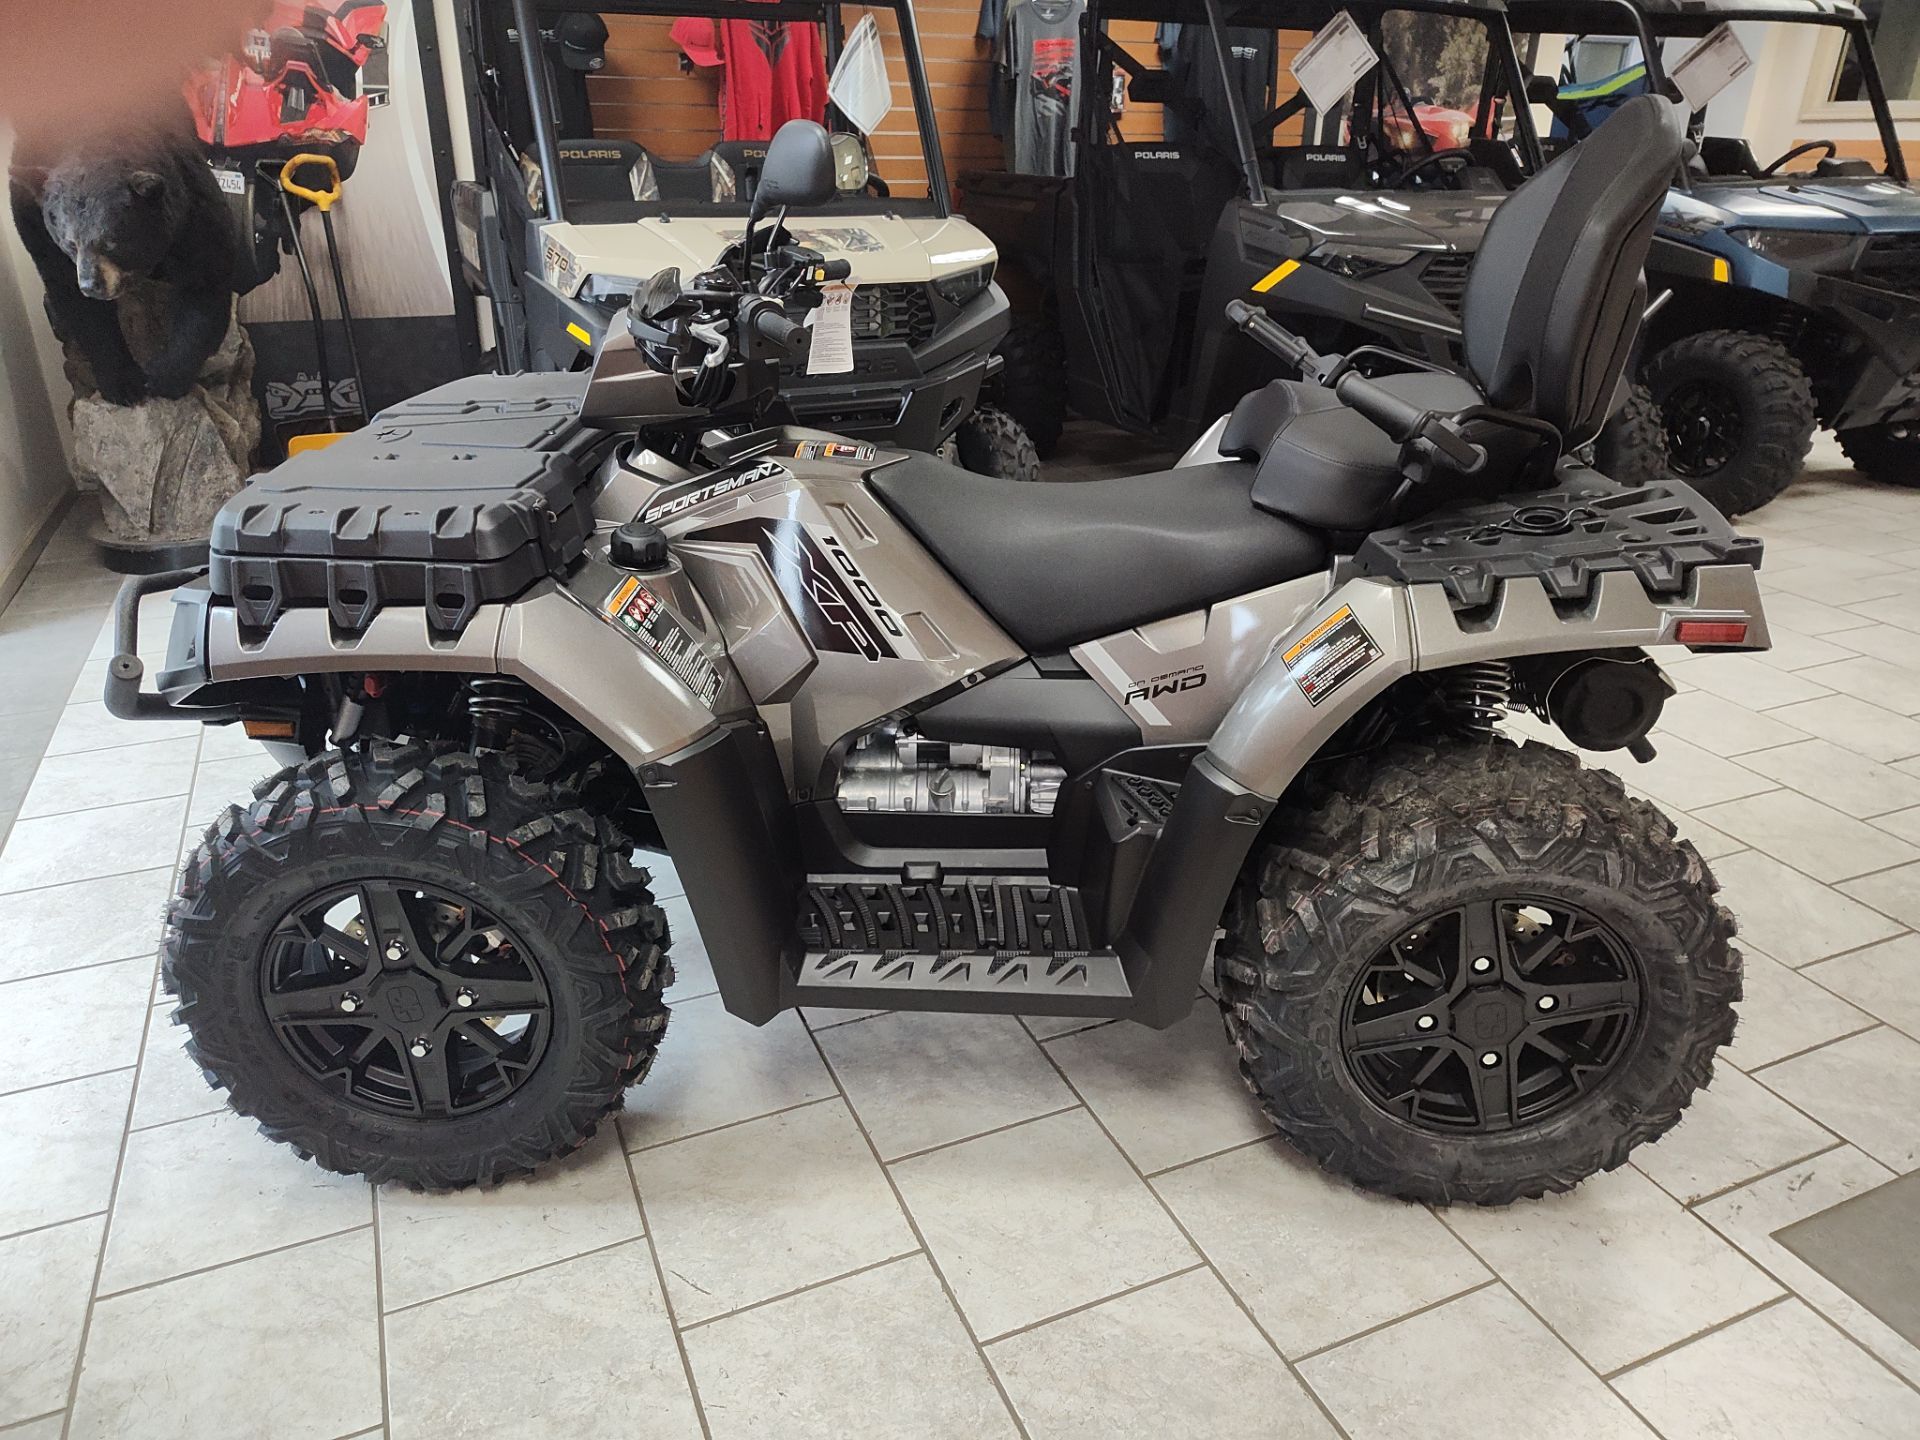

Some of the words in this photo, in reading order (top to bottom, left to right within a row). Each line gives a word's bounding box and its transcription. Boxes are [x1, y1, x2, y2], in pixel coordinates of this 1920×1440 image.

[560, 150, 621, 159] POLARIS
[1135, 151, 1180, 159] POLARIS
[1306, 153, 1346, 162] POLARIS
[546, 246, 569, 271] 570
[644, 461, 782, 524] SPORTSMAN
[761, 527, 881, 662] XP
[822, 536, 903, 637] 1000
[1304, 619, 1335, 645] WARNING
[1124, 672, 1207, 706] AWD
